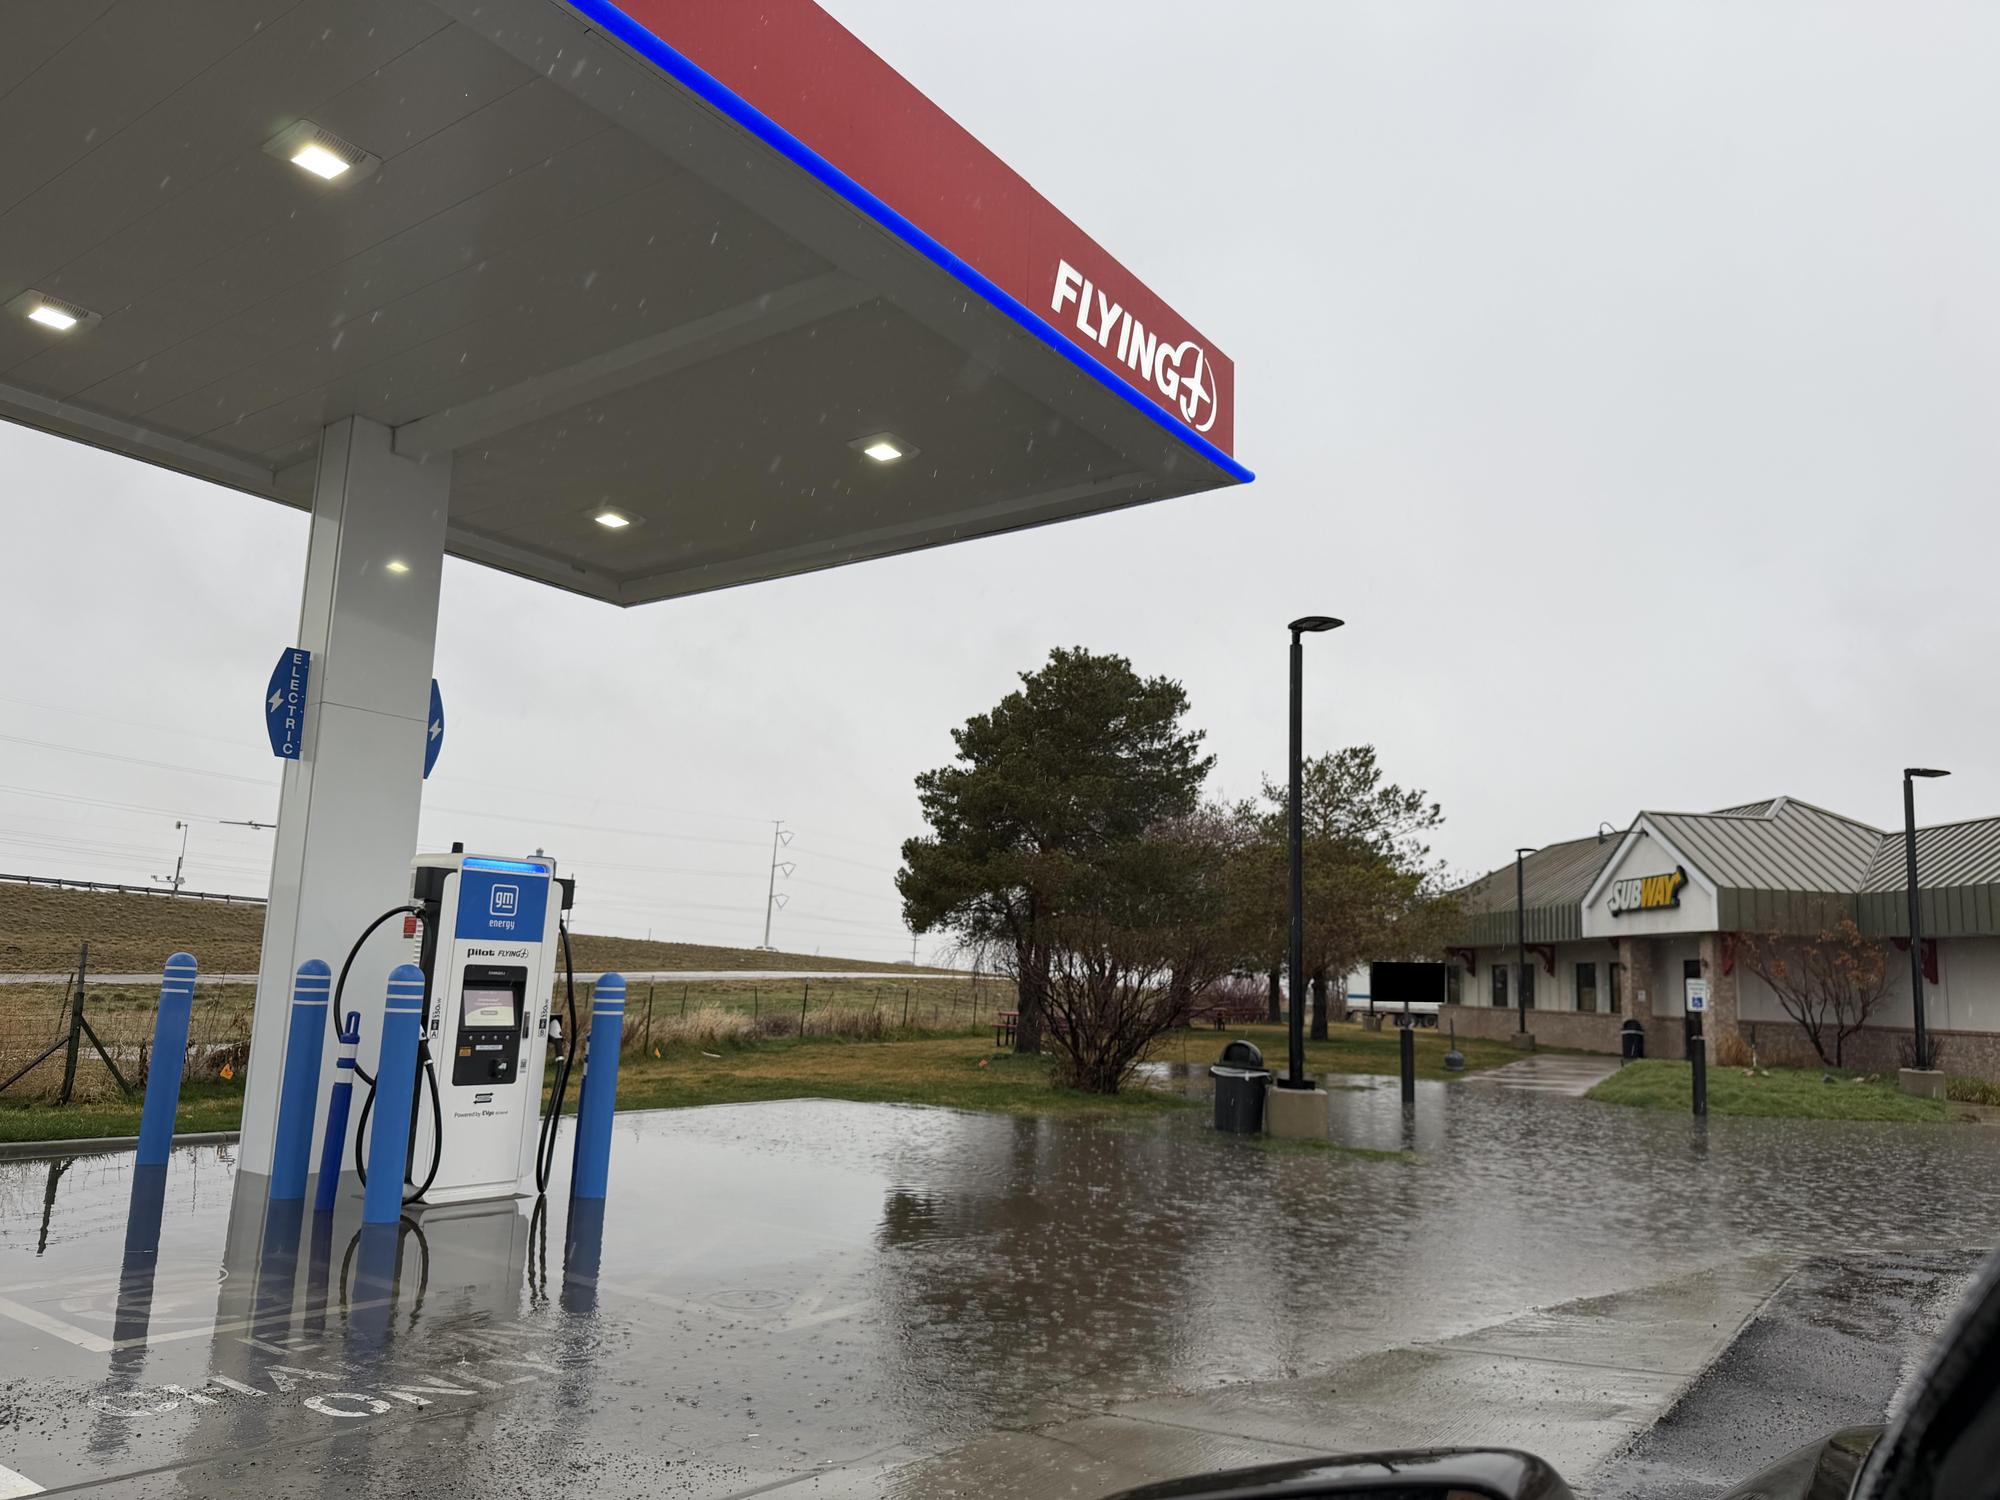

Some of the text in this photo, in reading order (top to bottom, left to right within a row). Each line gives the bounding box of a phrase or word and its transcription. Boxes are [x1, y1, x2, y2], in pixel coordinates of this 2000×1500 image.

[1051, 258, 1180, 401] FLYING
[282, 653, 303, 755] ELECTRIC
[495, 891, 514, 909] gm
[1610, 871, 1682, 911] SUBWAY
[489, 919, 515, 930] energy
[497, 949, 521, 958] FLYING
[303, 1351, 567, 1417] ONLY
